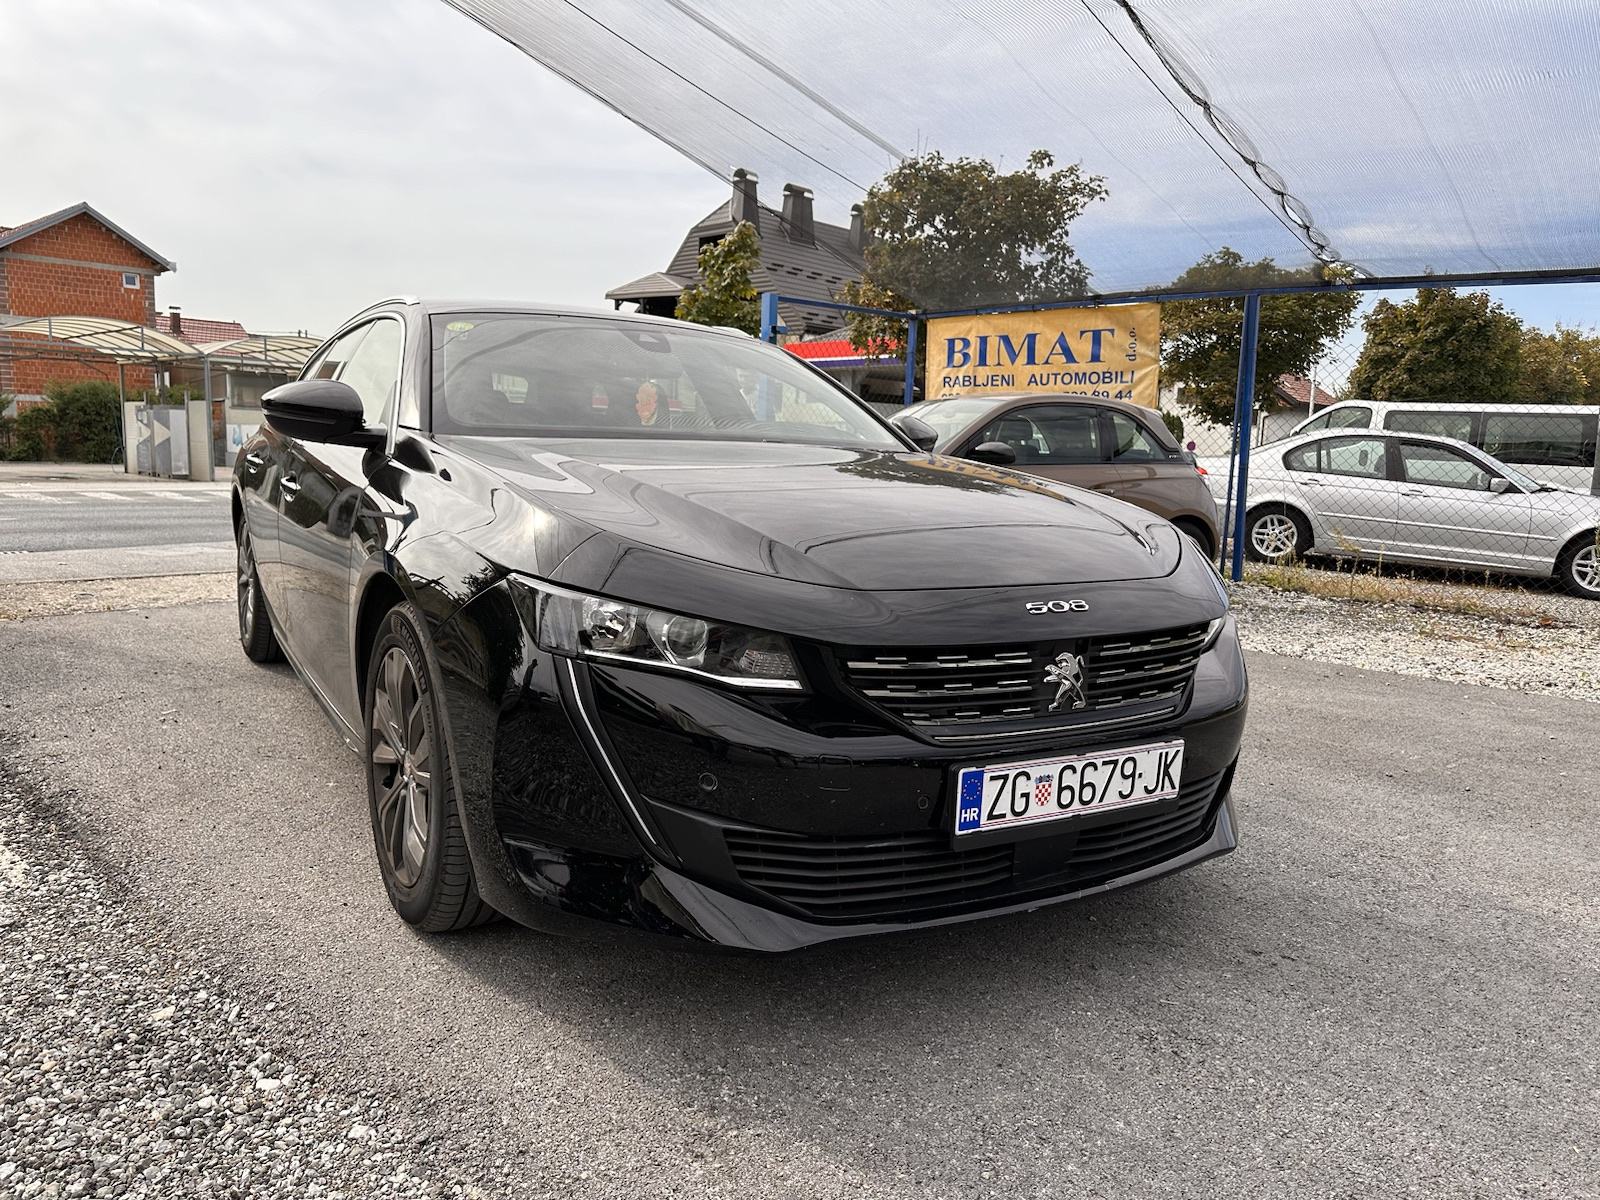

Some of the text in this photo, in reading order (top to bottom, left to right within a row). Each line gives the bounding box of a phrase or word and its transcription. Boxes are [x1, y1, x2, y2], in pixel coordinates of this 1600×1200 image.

[944, 328, 1116, 368] BIMAT
[1125, 326, 1138, 362] d.o.o.
[943, 370, 1135, 388] RABLJENI AUTOMOBILI
[1025, 599, 1090, 615] 508
[986, 770, 1032, 822] ZG
[960, 807, 980, 823] HR
